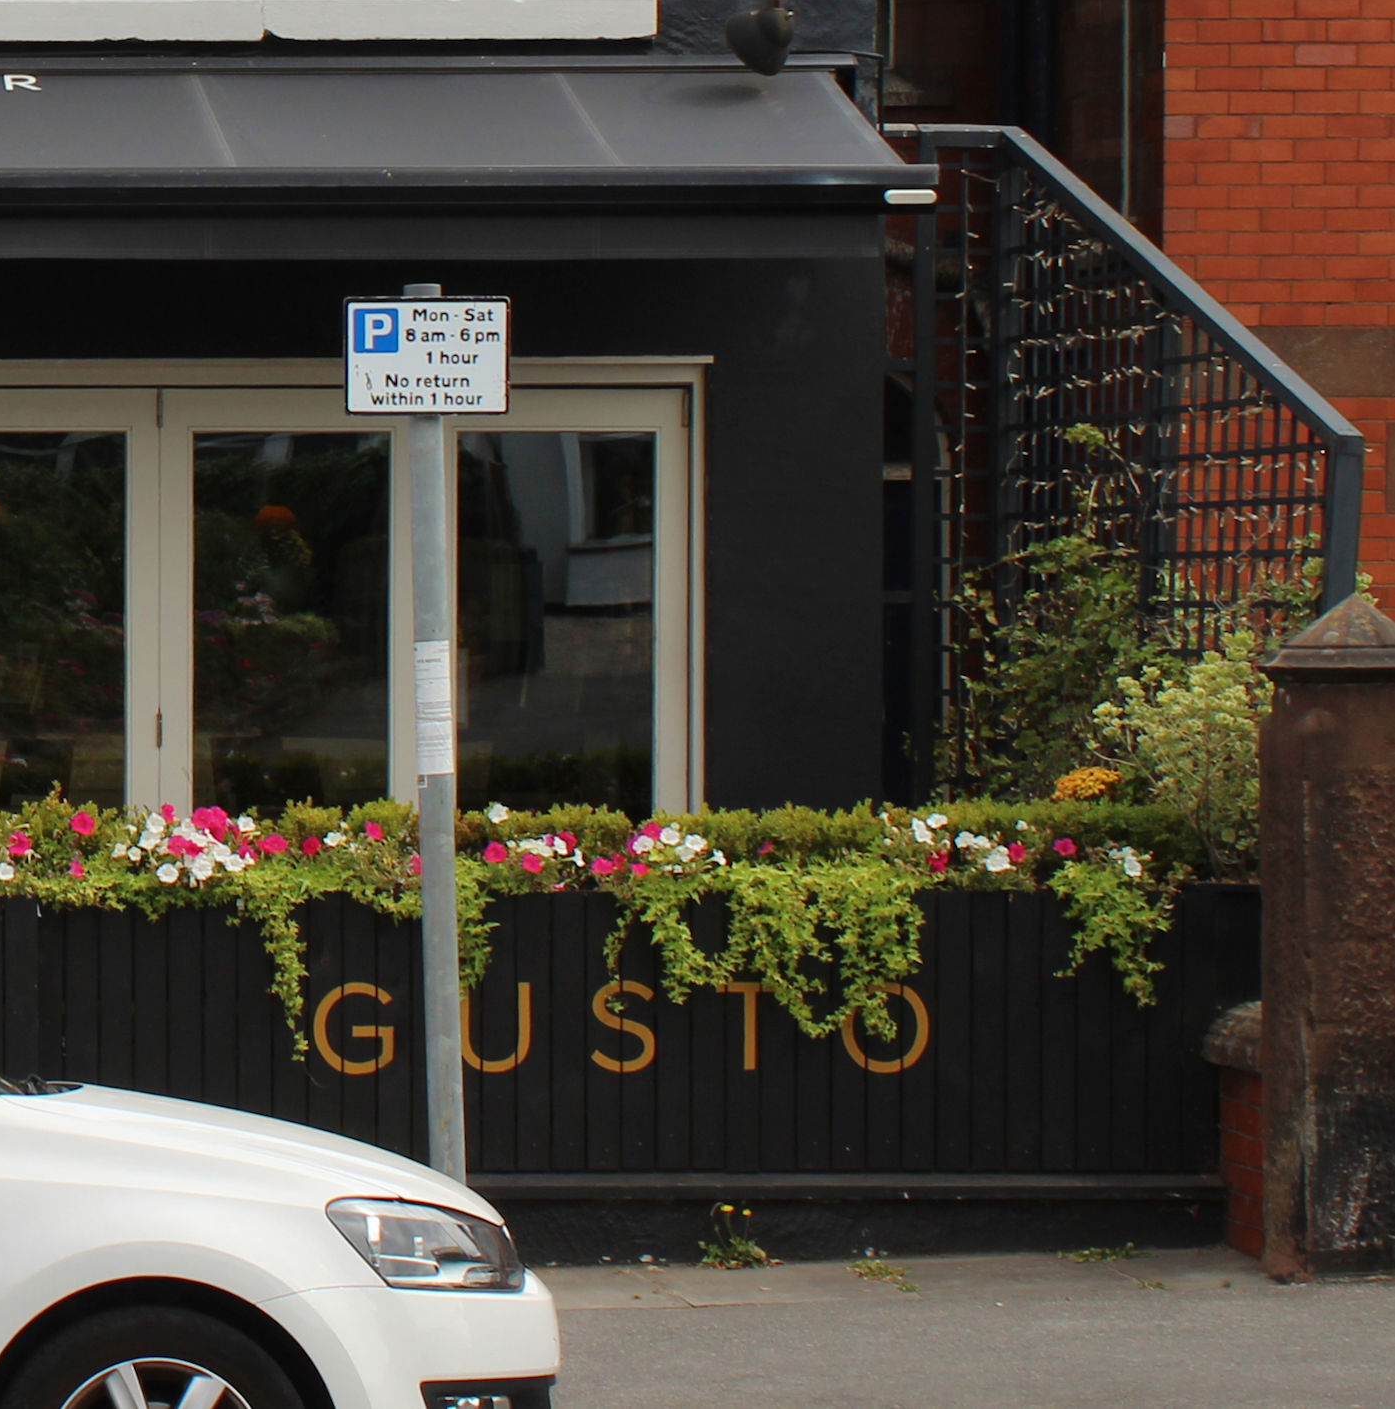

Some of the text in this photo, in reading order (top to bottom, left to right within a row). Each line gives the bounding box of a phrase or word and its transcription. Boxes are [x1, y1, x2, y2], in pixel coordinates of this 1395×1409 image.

[412, 308, 449, 321] Mon
[463, 308, 494, 321] Sat
[426, 351, 479, 364] 1 hour
[385, 374, 470, 387] No return
[371, 392, 482, 405] within 1 hour
[313, 980, 930, 1076] GUSTO
